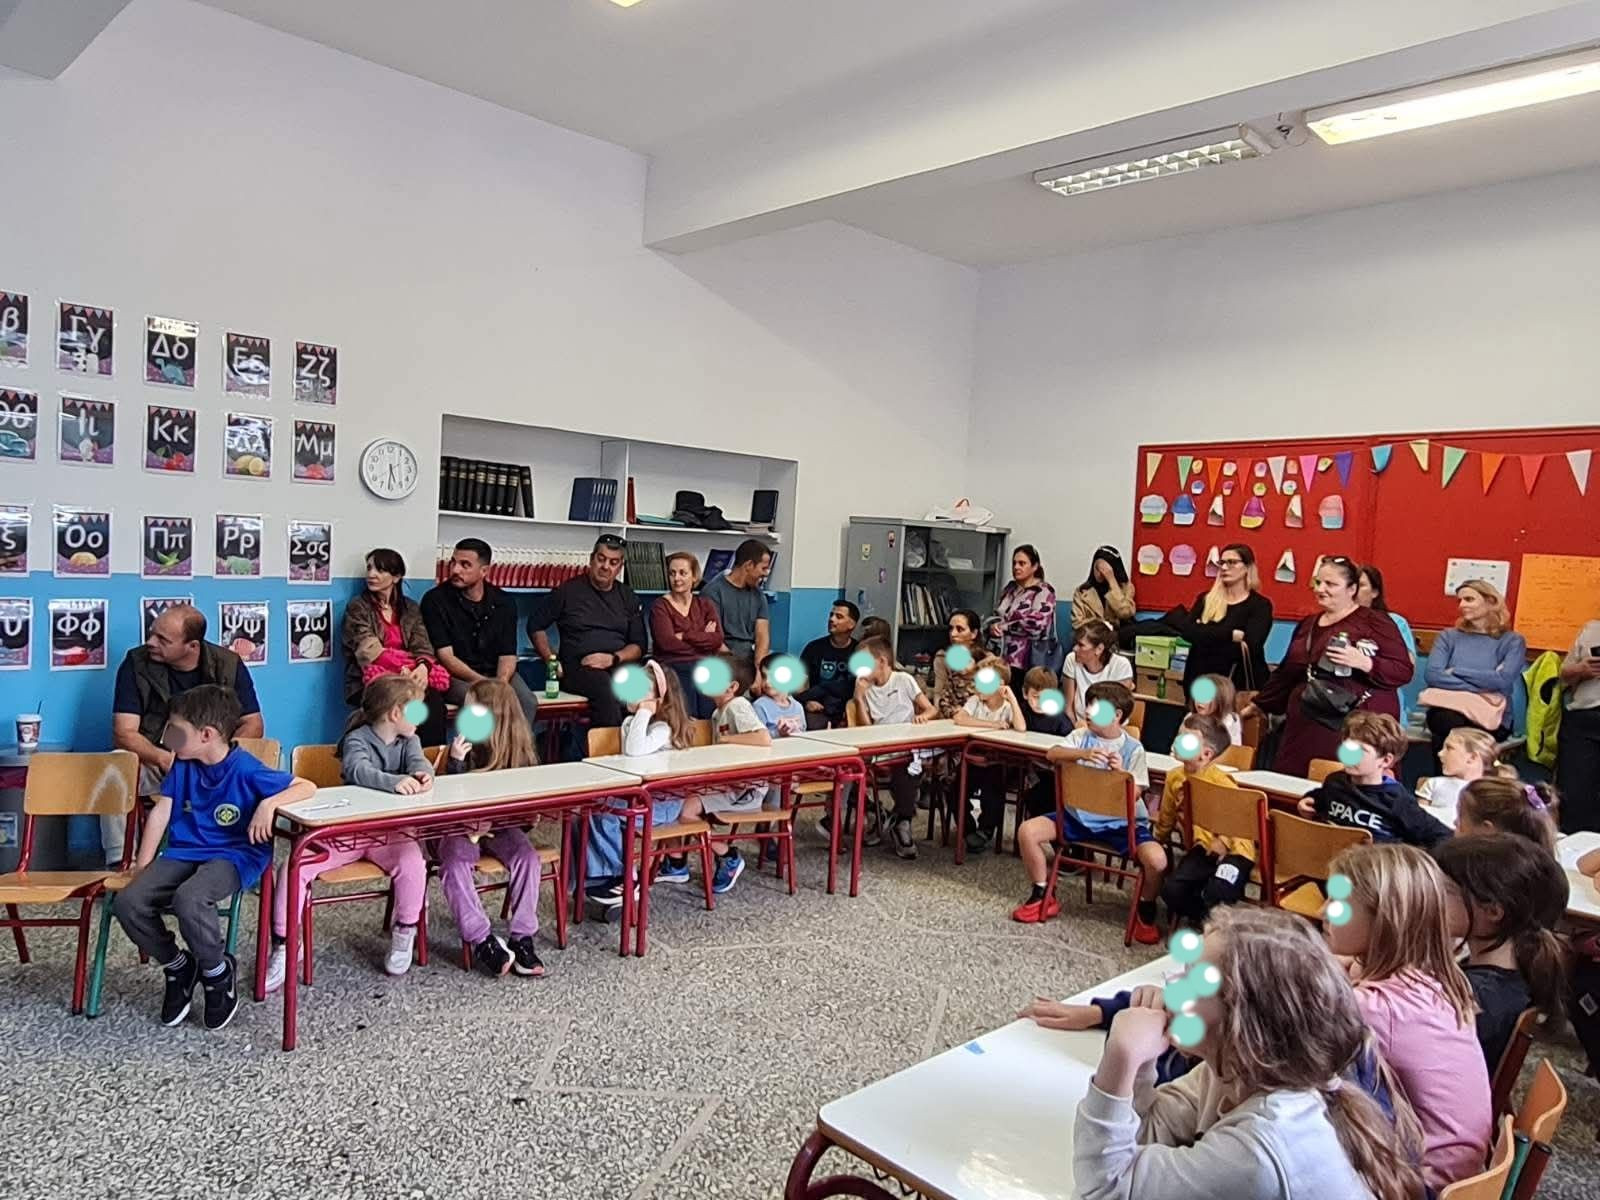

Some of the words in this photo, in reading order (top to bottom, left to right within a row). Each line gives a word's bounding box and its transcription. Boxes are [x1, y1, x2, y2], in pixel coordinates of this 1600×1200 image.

[69, 315, 106, 351] Γγ
[151, 331, 190, 358] Δδ
[301, 354, 332, 387] Ζζ
[152, 416, 190, 445] Κκ
[295, 433, 333, 457] Μμ
[65, 524, 104, 549] Οο
[150, 526, 187, 550] Ππ
[223, 525, 256, 556] Ρρ
[291, 535, 330, 561] Σσς
[56, 611, 101, 641] Φφ
[224, 615, 261, 637] Ψψ
[294, 612, 328, 633] Ωω
[1328, 800, 1384, 830] SPACE
